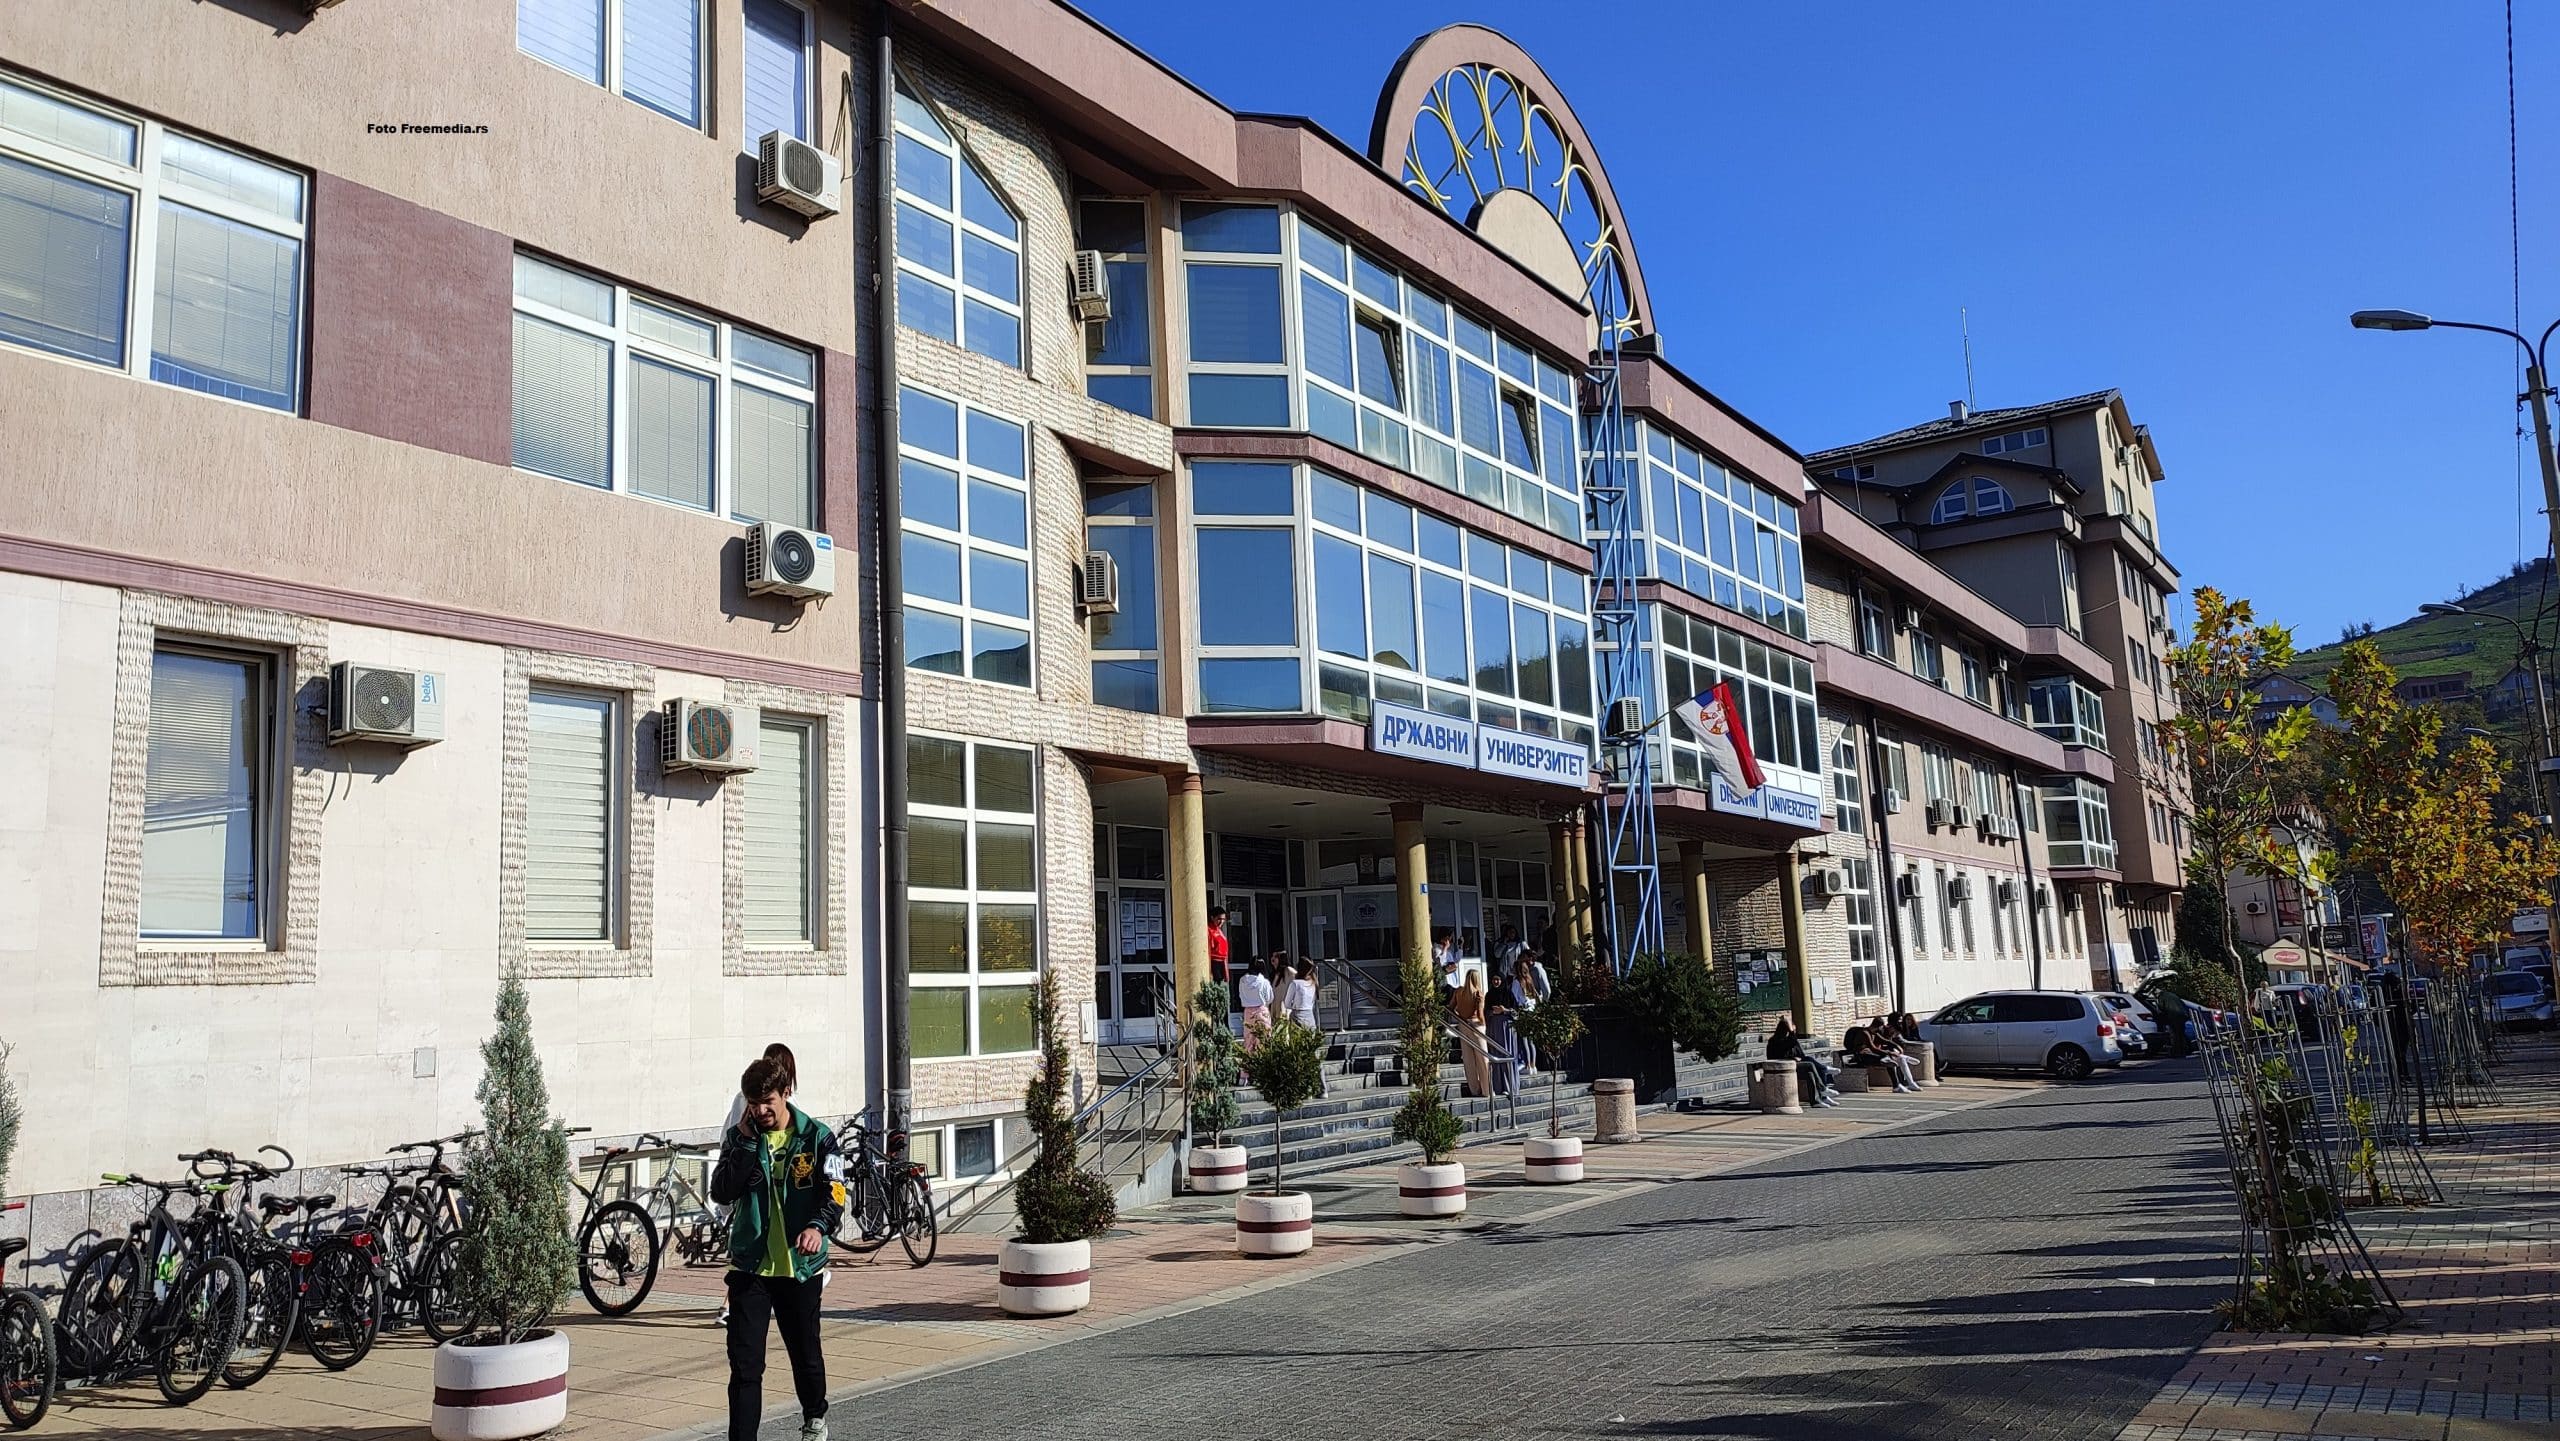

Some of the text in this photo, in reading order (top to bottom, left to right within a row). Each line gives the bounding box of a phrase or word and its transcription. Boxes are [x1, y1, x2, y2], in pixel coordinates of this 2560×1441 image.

[421, 674, 431, 703] beko
[1382, 714, 1585, 777] ДРЖАВНИ УНИВЕРЗИТЕТ
[1719, 783, 1818, 821] DRVNI UNIVERZITET
